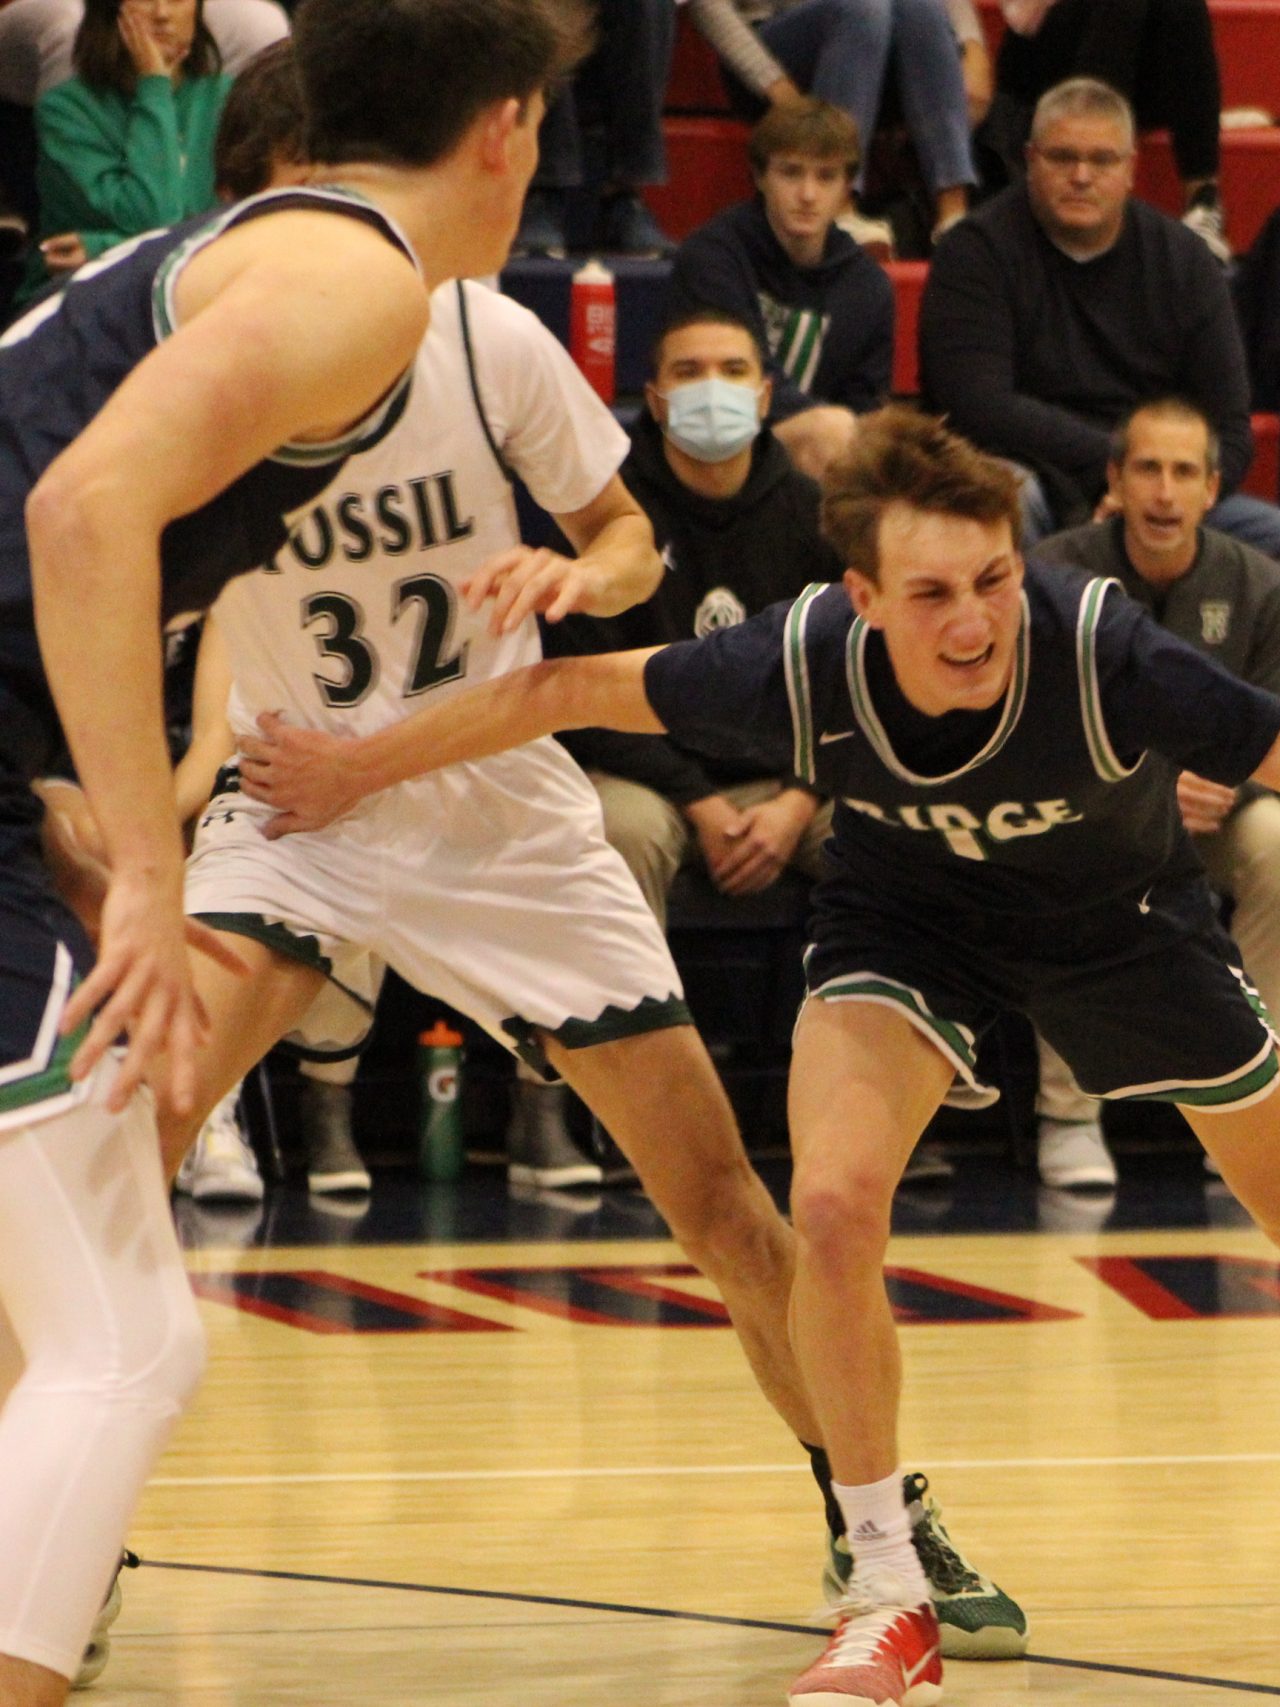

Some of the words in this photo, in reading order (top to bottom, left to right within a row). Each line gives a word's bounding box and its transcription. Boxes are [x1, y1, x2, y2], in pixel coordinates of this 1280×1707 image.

[263, 469, 475, 576] OSSIL
[302, 572, 471, 709] 32
[427, 1067, 458, 1104] G
